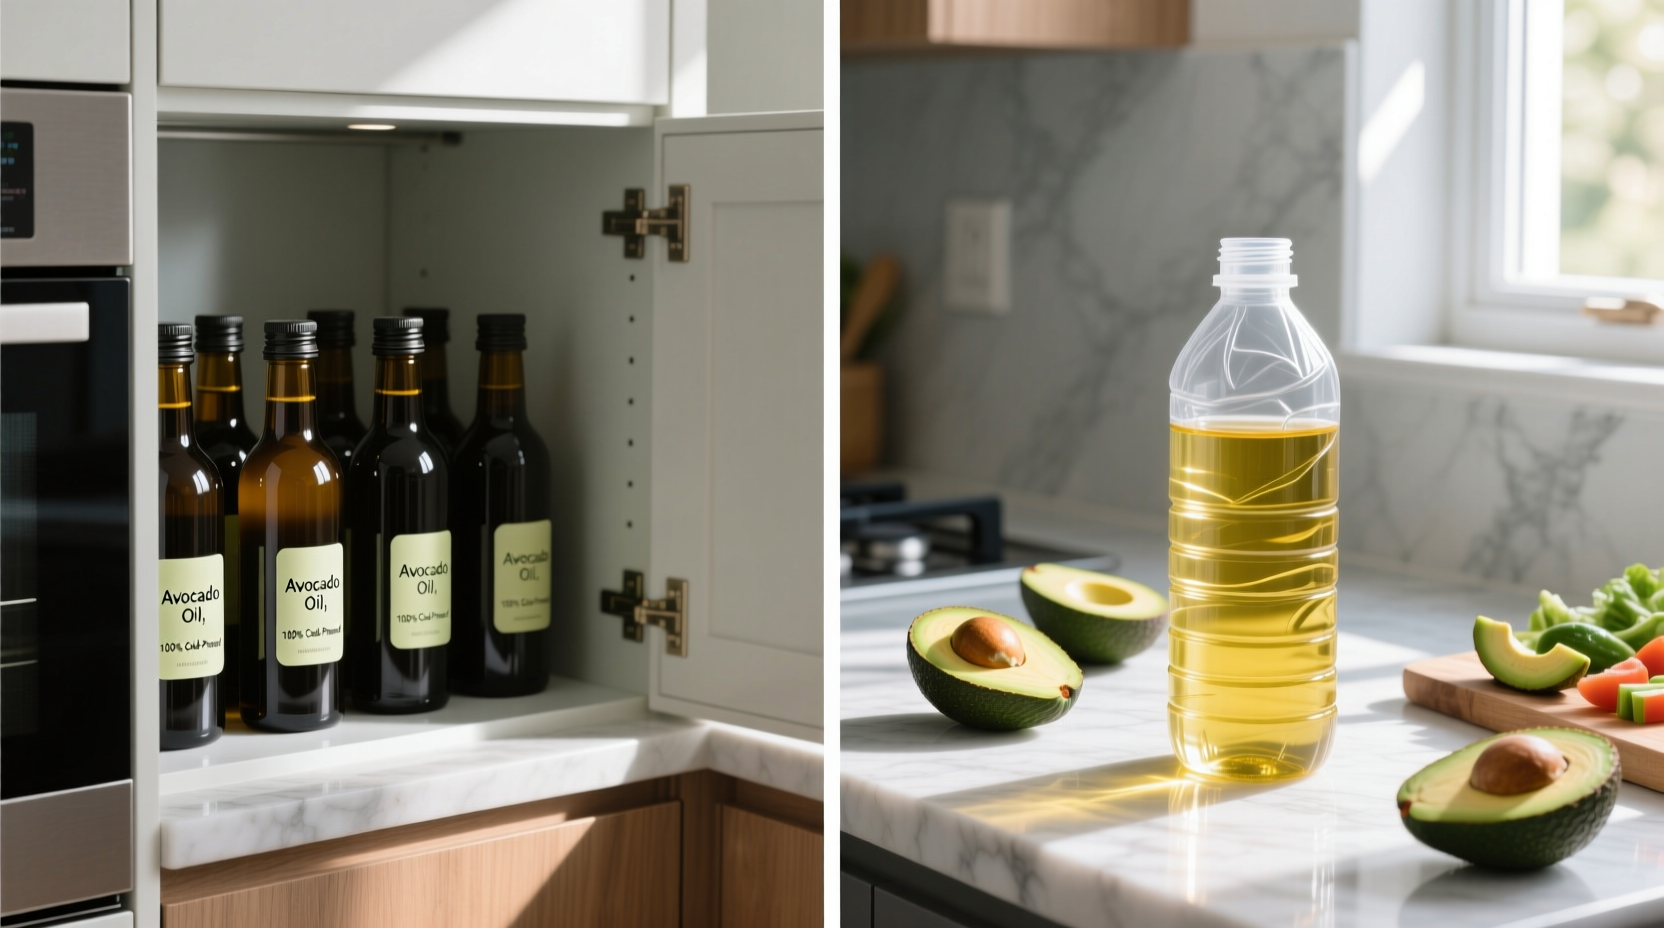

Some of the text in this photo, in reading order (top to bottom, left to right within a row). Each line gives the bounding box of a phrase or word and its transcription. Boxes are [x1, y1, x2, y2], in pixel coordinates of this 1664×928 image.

[399, 560, 448, 578] Avocado
[285, 574, 340, 593] Avocado
[417, 580, 437, 595] Oil,
[161, 585, 220, 605] Avocado
[304, 595, 327, 612] Oil,
[182, 607, 206, 625] Oil,
[282, 630, 303, 640] 100%
[159, 642, 183, 653] 100%
